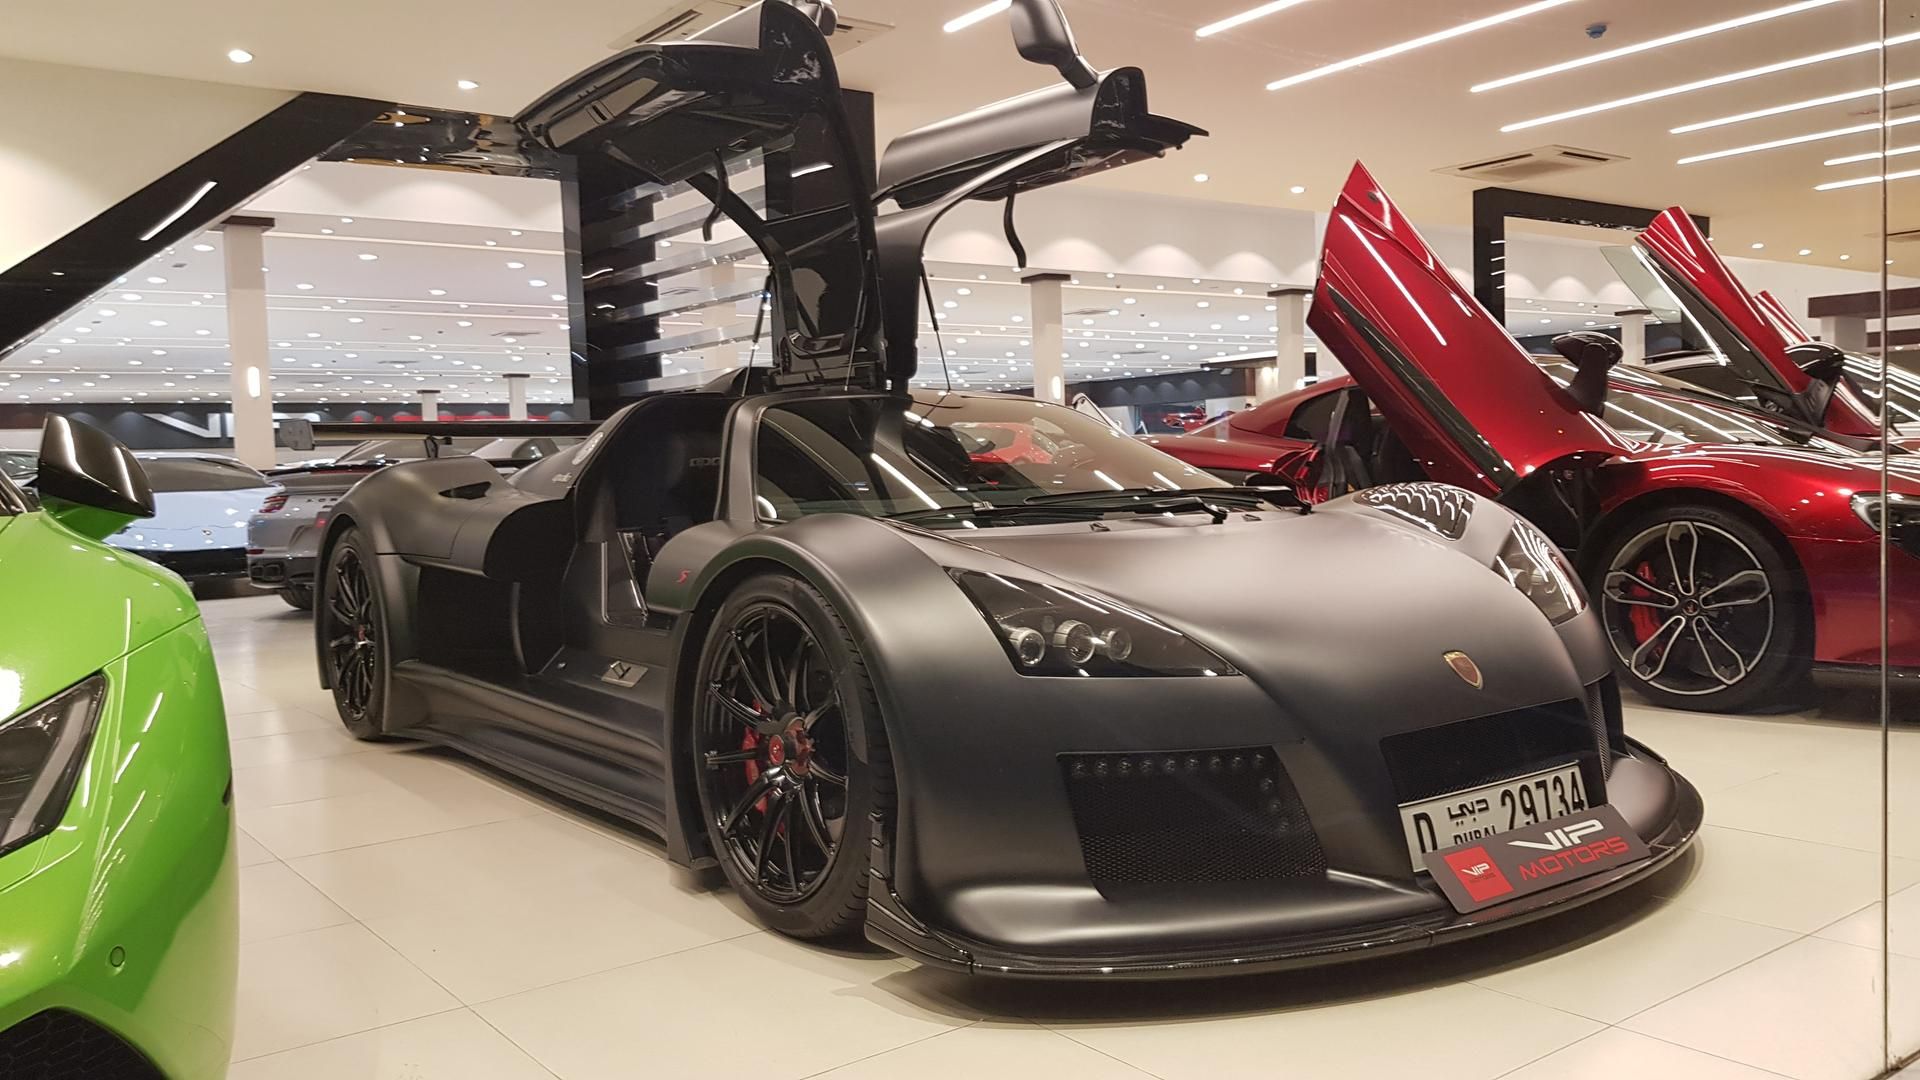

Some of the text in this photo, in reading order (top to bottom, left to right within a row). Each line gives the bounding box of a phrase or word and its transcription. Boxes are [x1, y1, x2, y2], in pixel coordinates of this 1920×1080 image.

[1447, 799, 1489, 826] دبي
[1501, 771, 1584, 830] 29734
[1413, 812, 1438, 853] D
[1507, 819, 1604, 851] VIP
[1461, 863, 1490, 875] VIP
[1519, 836, 1630, 881] MOTORS
